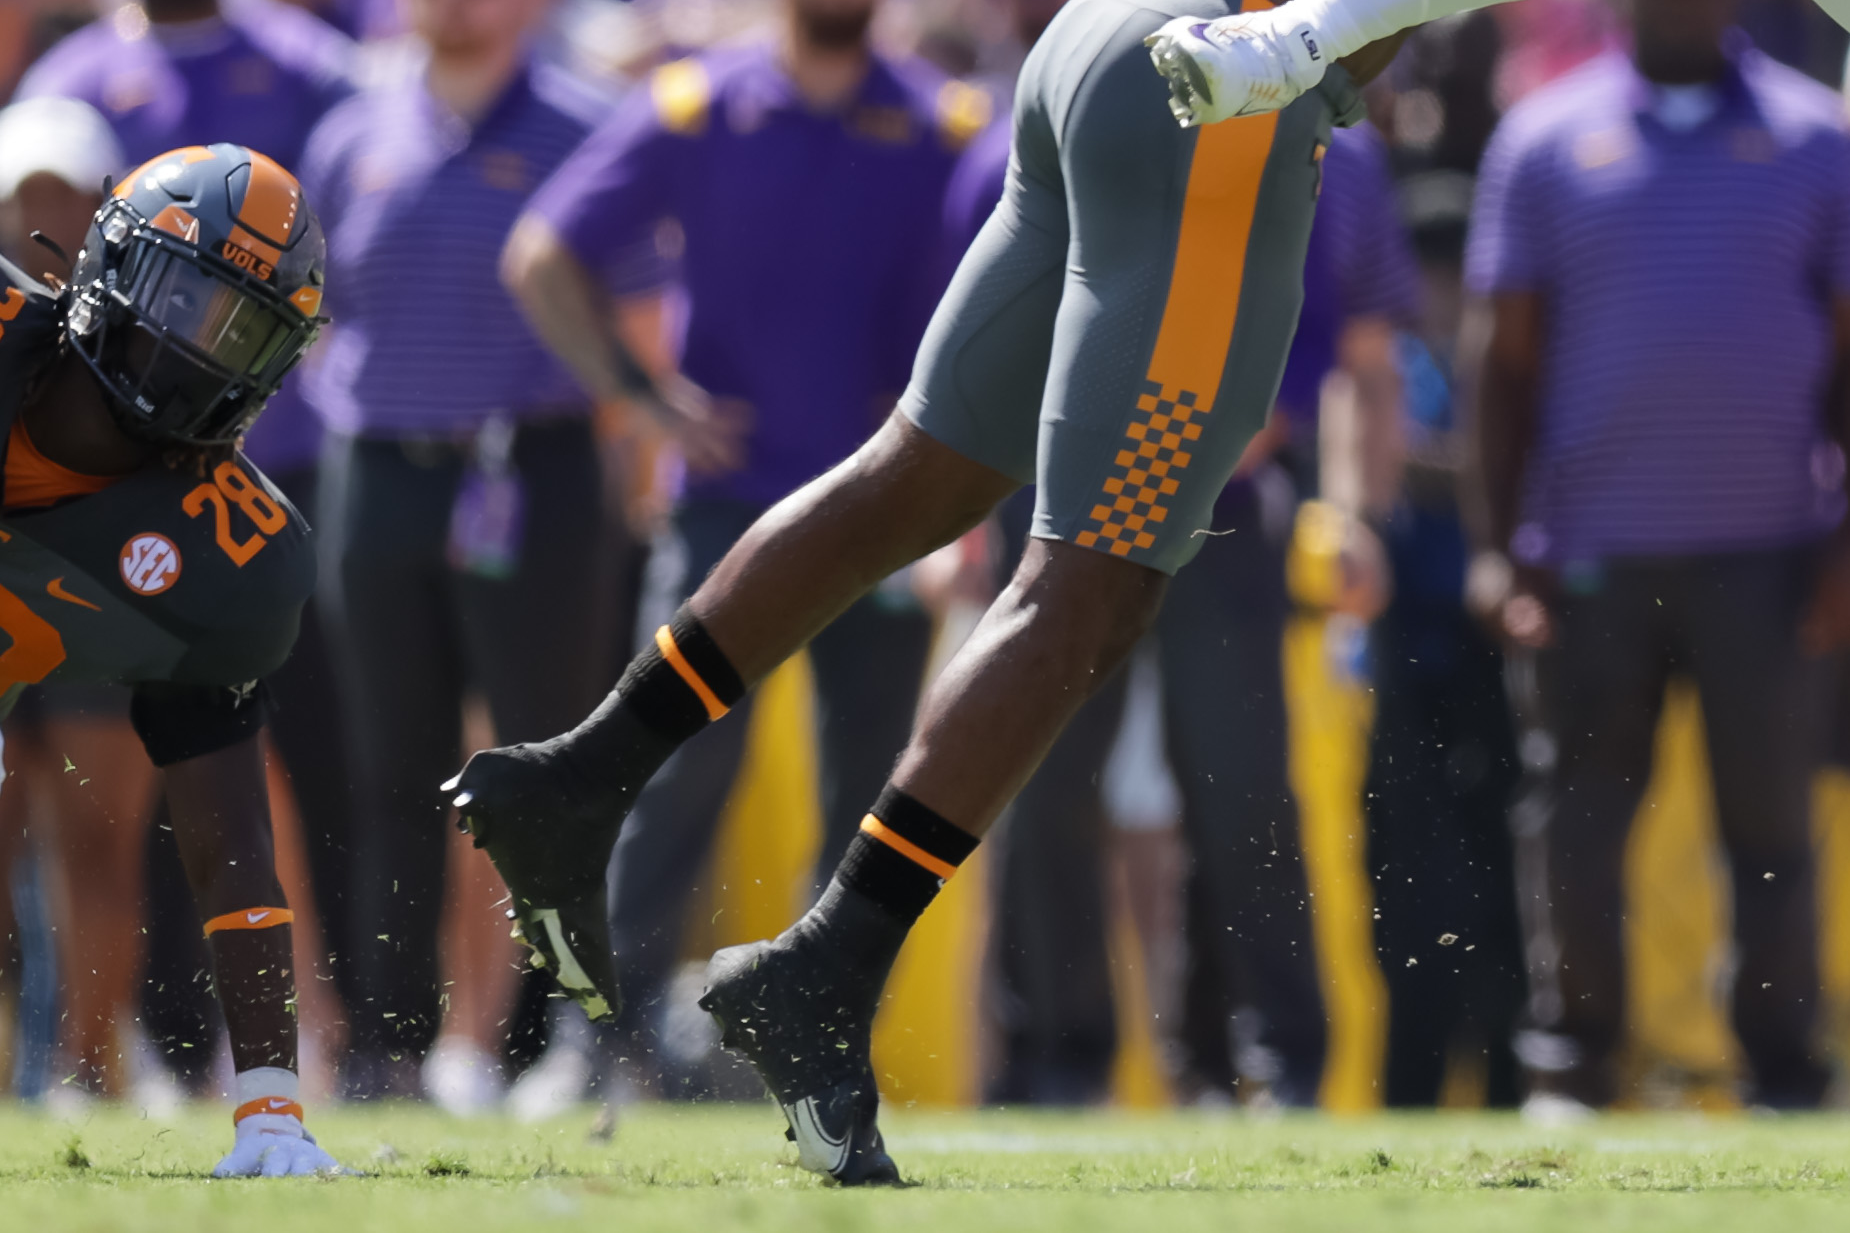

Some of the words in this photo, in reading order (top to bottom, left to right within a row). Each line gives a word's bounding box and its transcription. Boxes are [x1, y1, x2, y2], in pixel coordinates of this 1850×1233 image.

[1300, 29, 1321, 62] LSU
[222, 242, 274, 282] VOLS
[181, 461, 288, 568] 28
[121, 533, 180, 593] SEC
